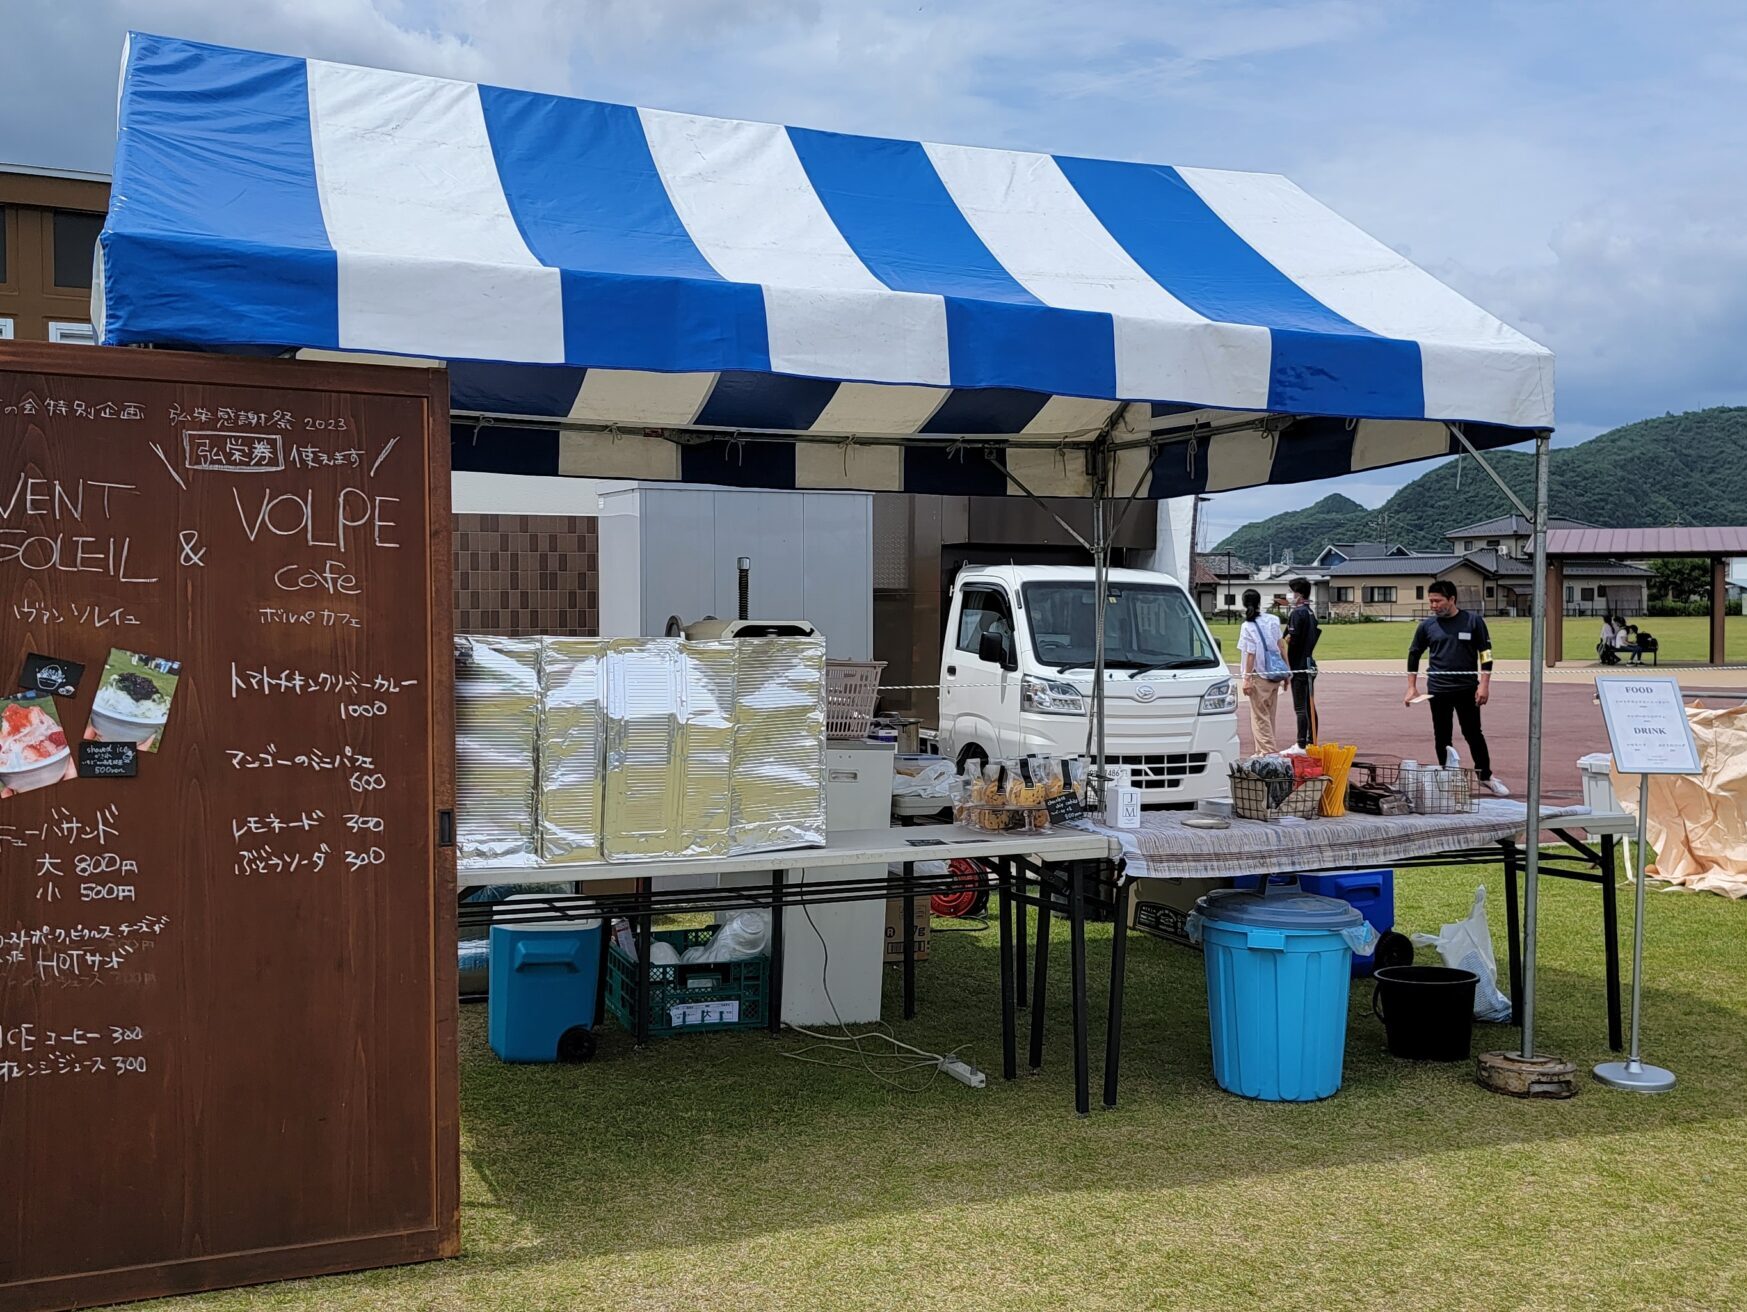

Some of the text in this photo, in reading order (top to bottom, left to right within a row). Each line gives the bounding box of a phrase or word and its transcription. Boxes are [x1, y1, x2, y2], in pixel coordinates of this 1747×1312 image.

[304, 417, 348, 431] 2023
[289, 442, 367, 469] 使えます
[0, 472, 138, 521] VENT
[233, 486, 400, 553] VOLPE
[178, 529, 207, 567] &
[340, 700, 388, 720] 1000
[1634, 727, 1667, 735] DRINK
[225, 743, 375, 771] マンゴーのミニパフェ
[350, 772, 387, 793] 600
[1127, 794, 1134, 804] J
[1125, 808, 1136, 817] M
[232, 809, 385, 846] レモネード 300
[36, 852, 138, 877] 大 800円
[234, 842, 386, 876] ぶどうソーダ 300
[35, 881, 135, 902] 小 500円
[0, 1023, 144, 1053] ICE コーヒー 300
[111, 1056, 148, 1077] 300
